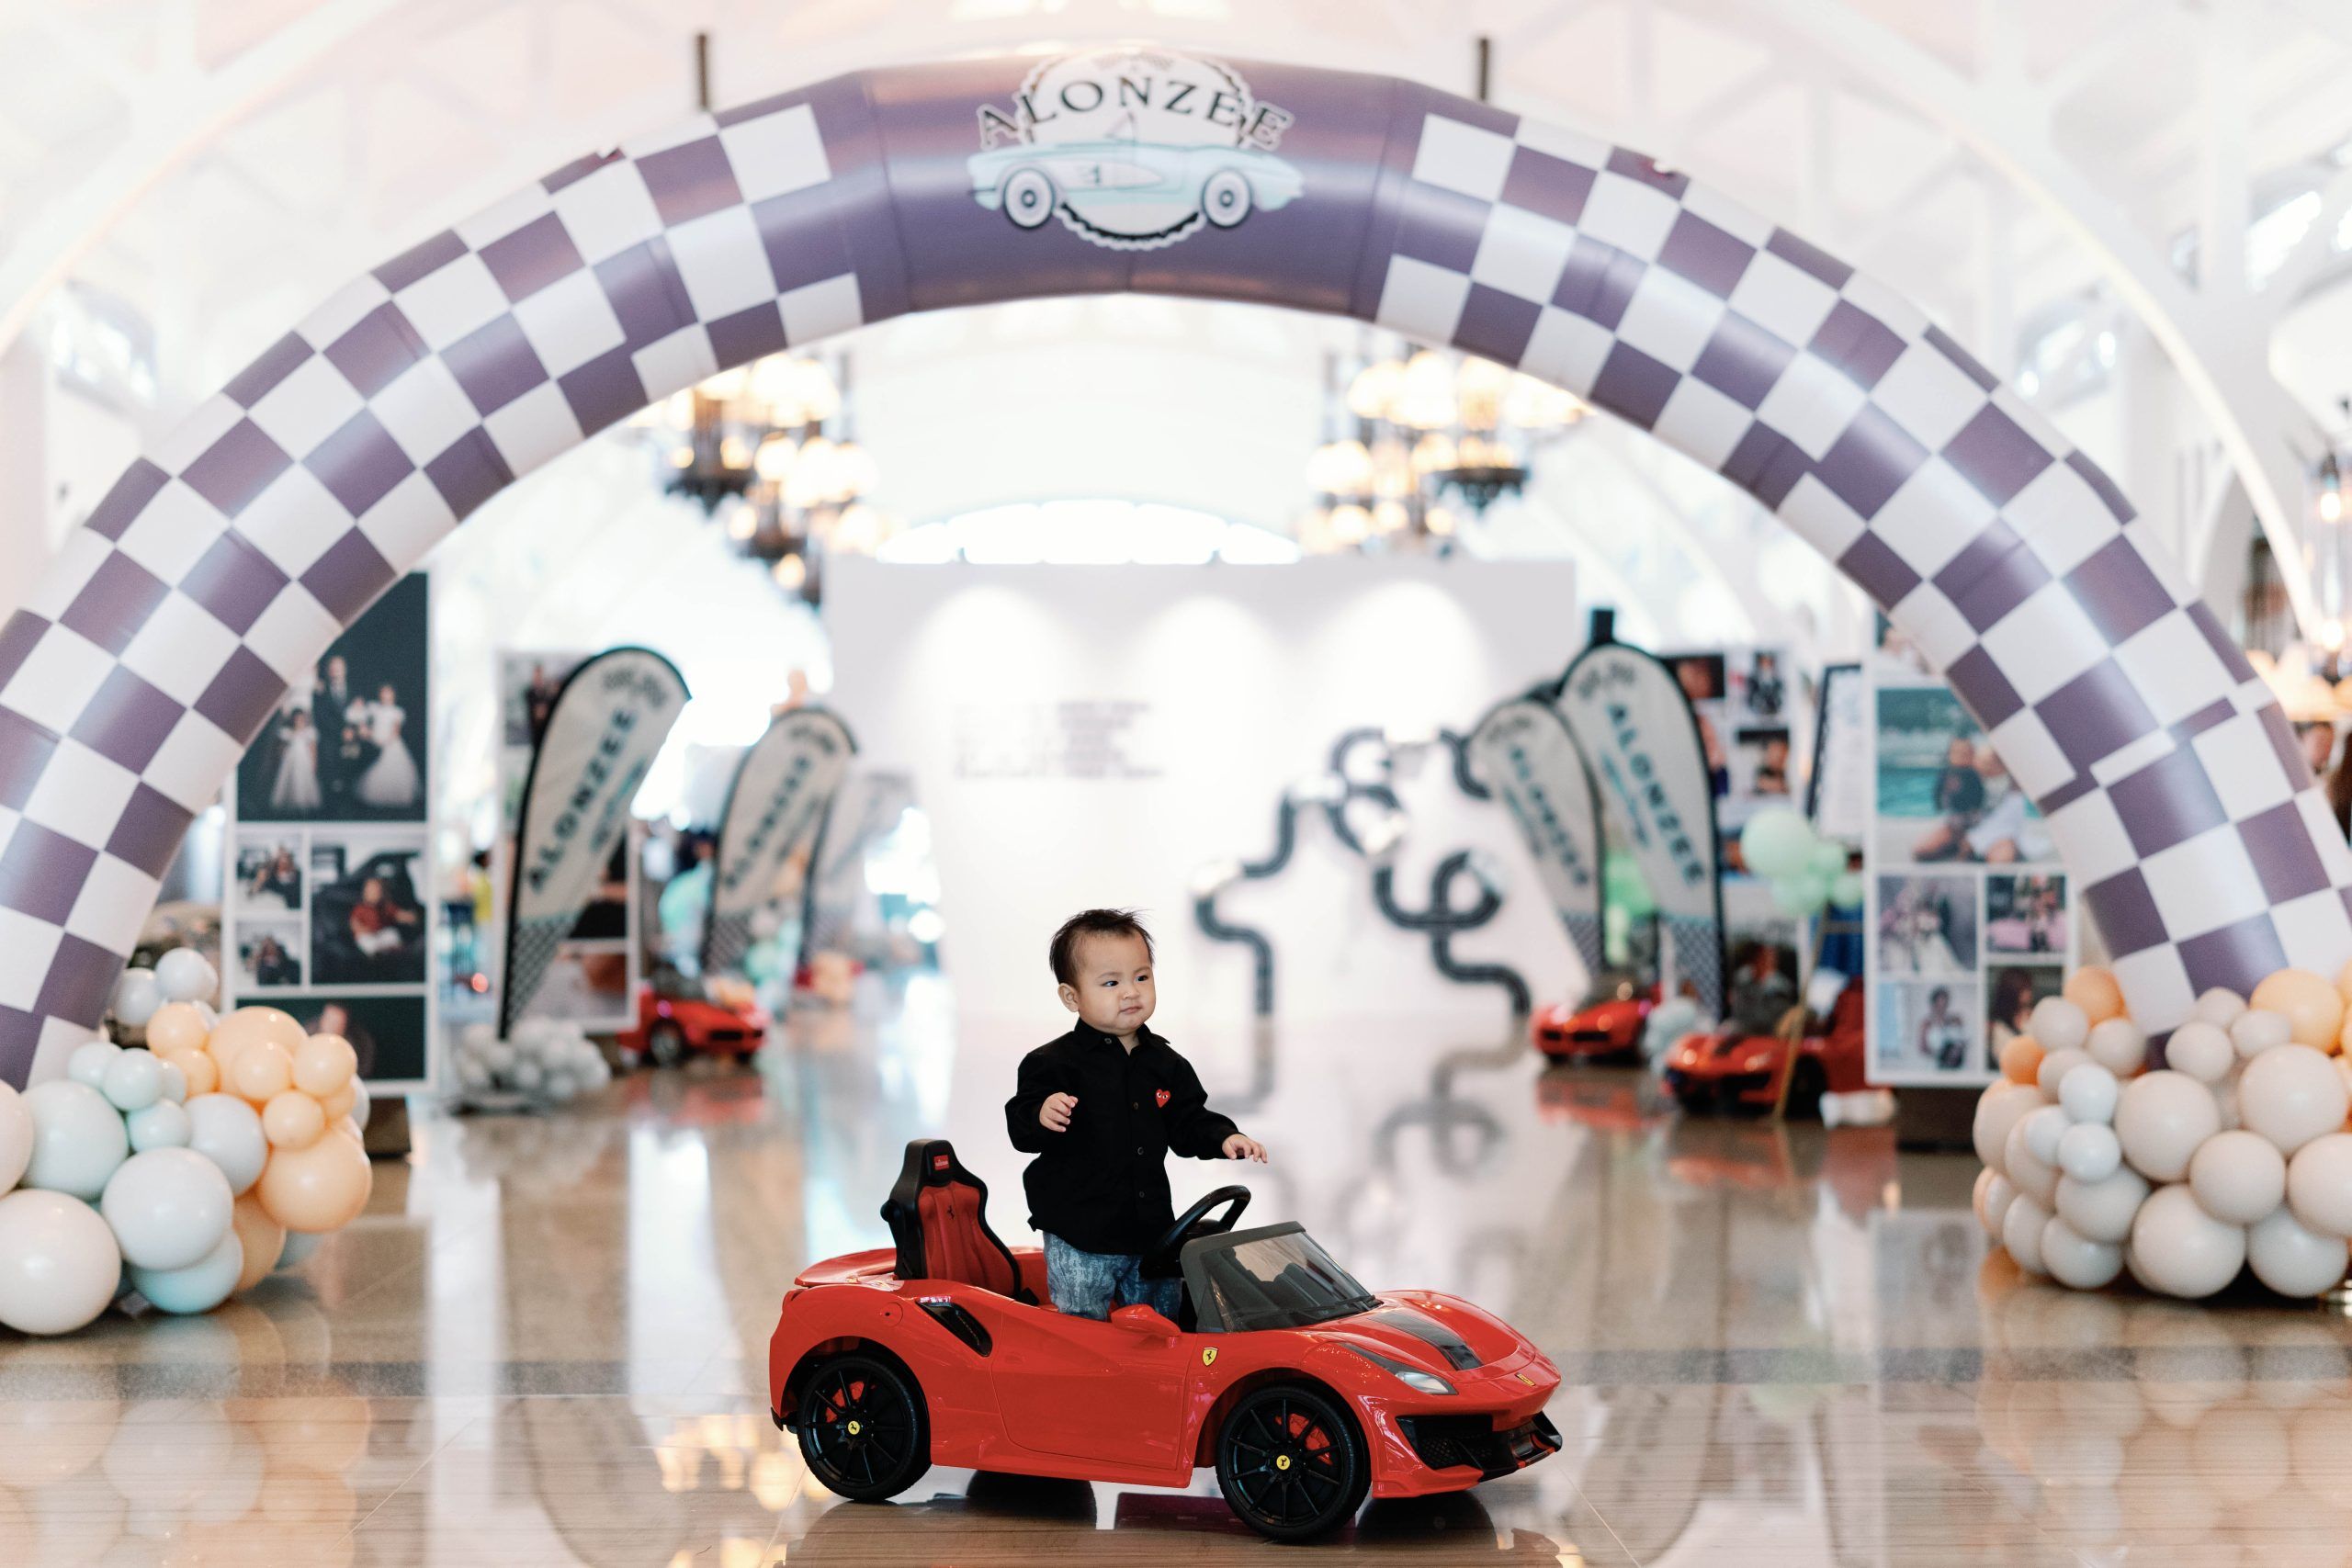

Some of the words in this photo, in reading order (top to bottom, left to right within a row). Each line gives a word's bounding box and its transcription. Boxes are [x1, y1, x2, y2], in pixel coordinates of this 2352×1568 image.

[980, 75, 1288, 147] ALONZEE
[528, 707, 638, 895] ALONZEE
[1607, 702, 1703, 886] ALONZEE
